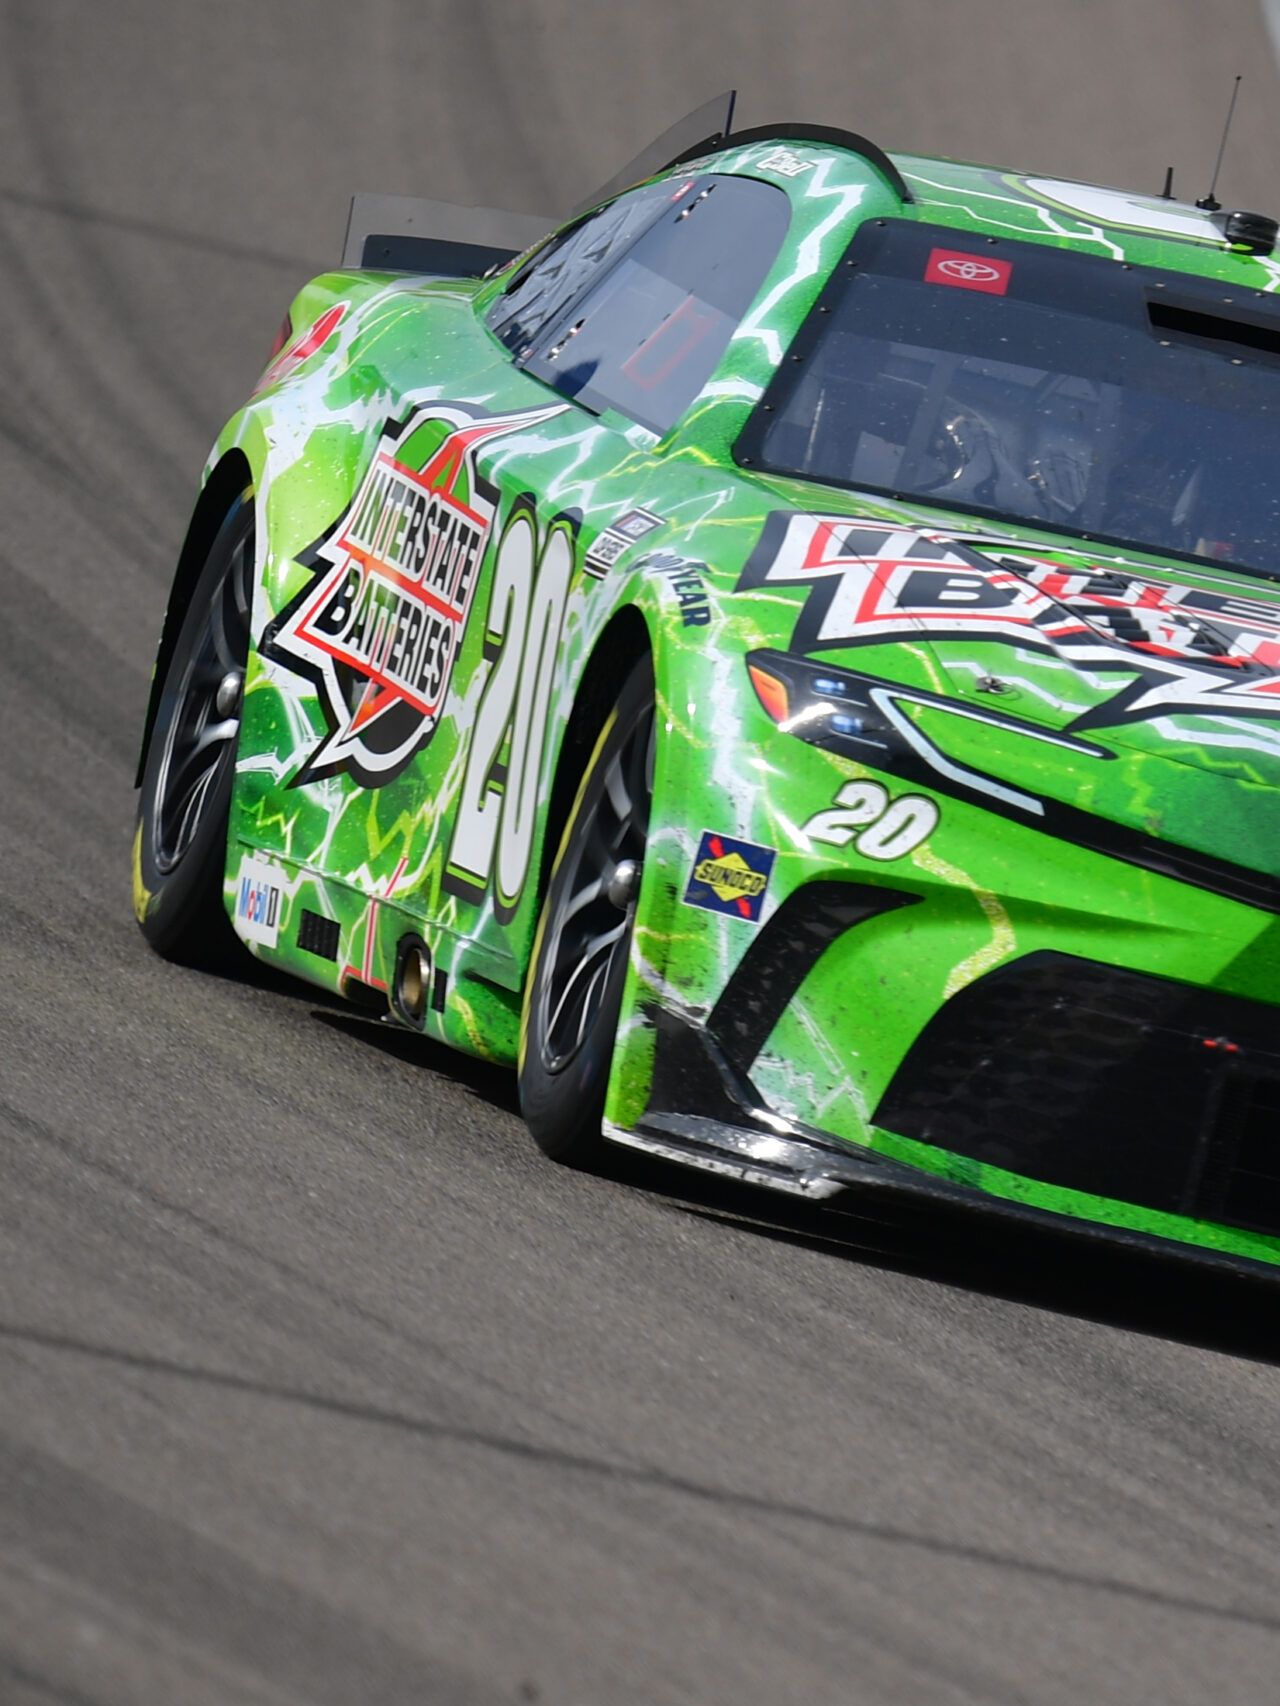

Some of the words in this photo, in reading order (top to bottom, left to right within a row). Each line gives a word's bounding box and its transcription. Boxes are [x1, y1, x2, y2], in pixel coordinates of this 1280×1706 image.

[352, 467, 482, 607] INTERSTATE
[313, 566, 453, 700] BATTERIES
[447, 512, 577, 905] 20
[801, 778, 941, 862] 20
[239, 877, 269, 924] Mobil
[699, 862, 764, 895] SUNOCO
